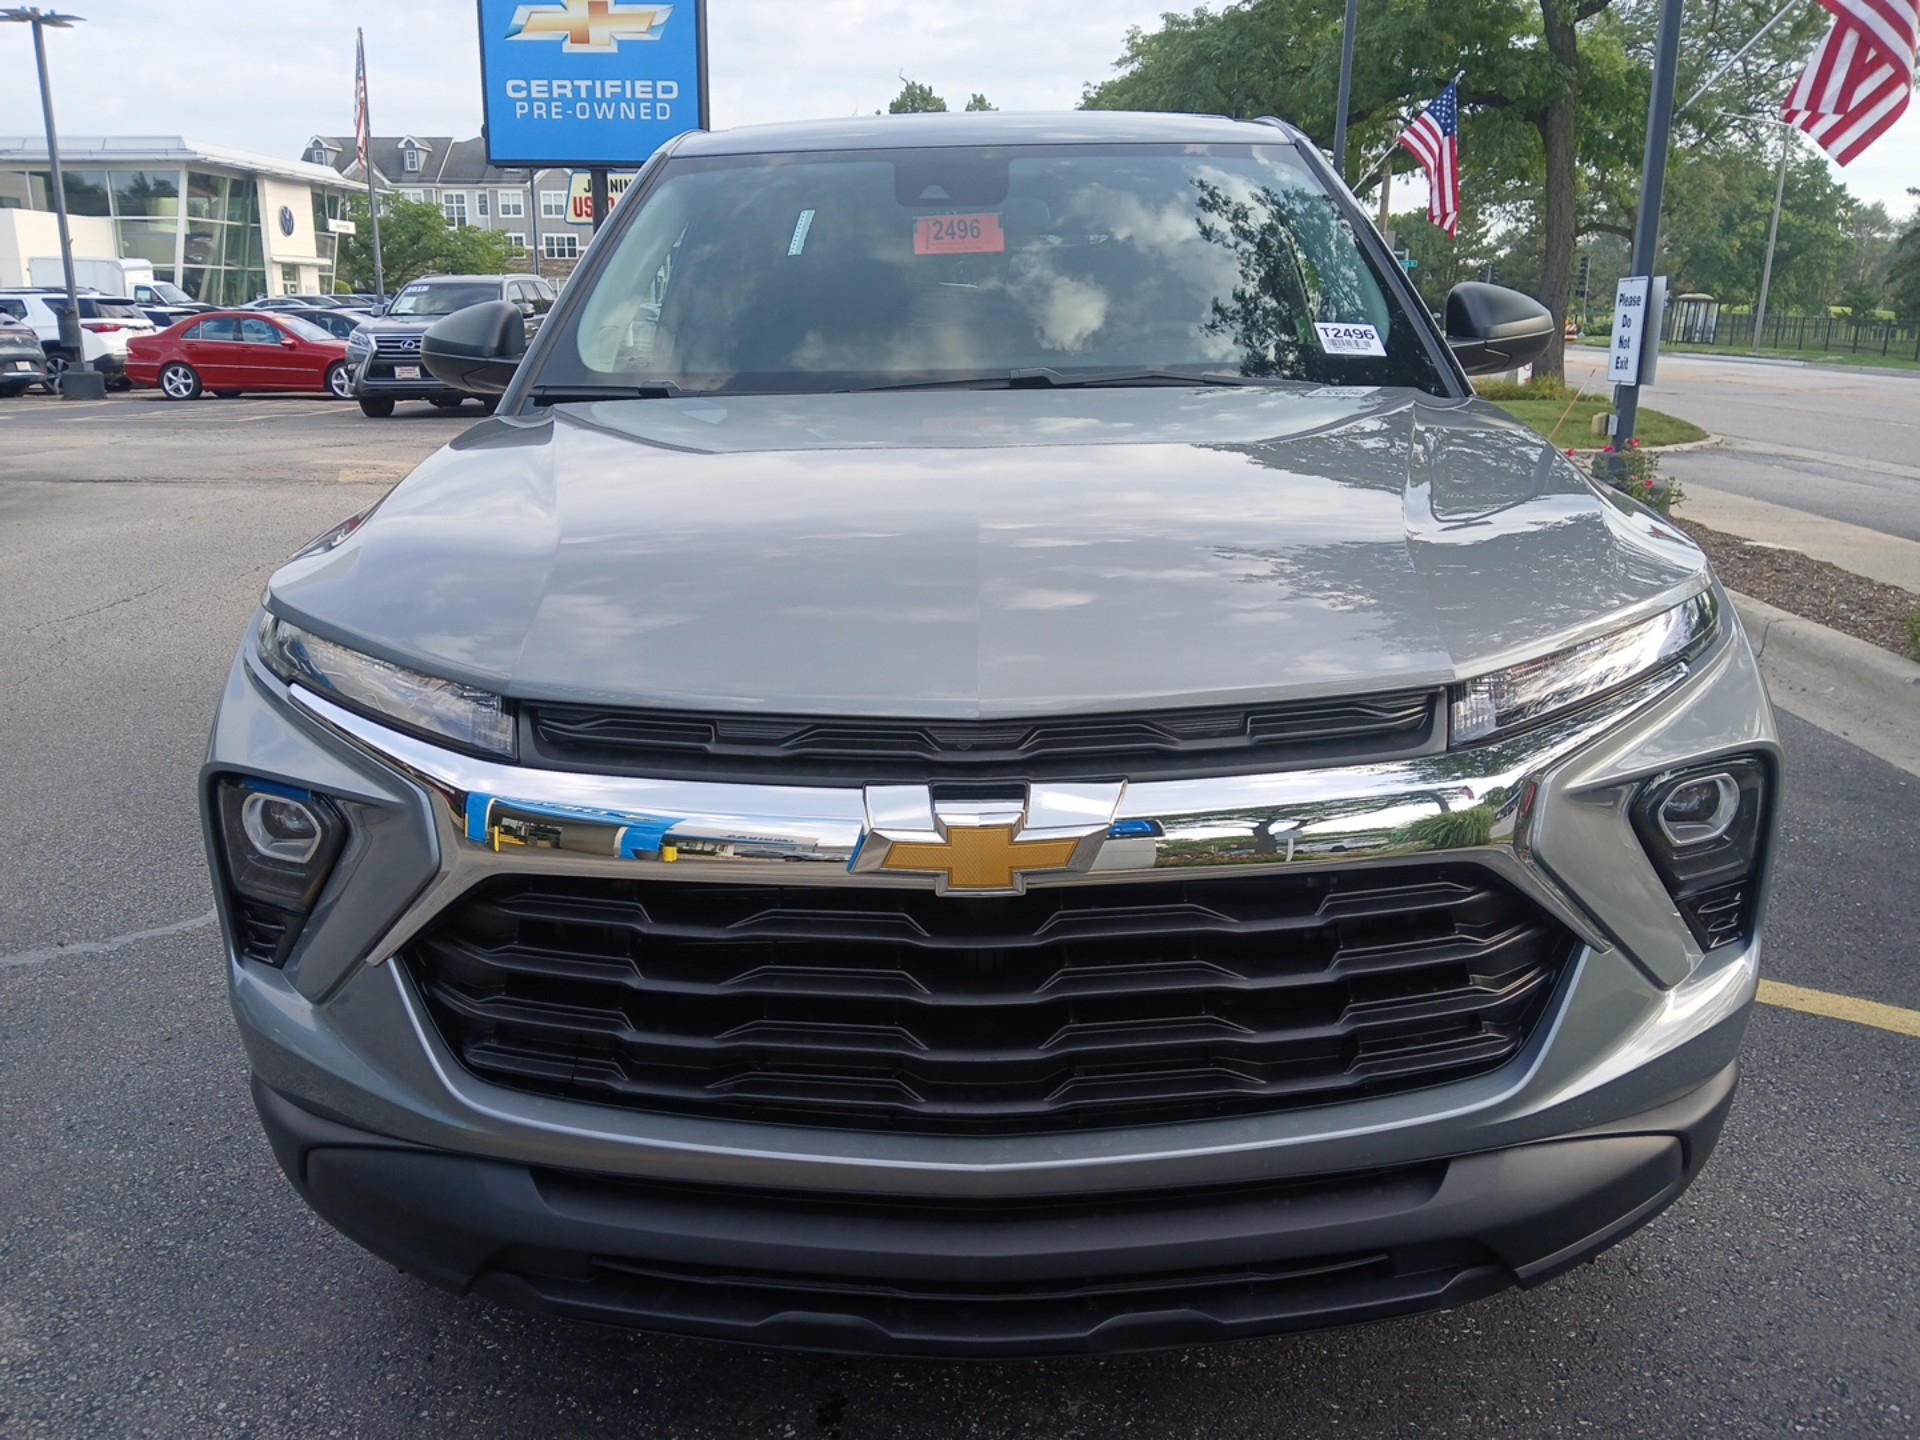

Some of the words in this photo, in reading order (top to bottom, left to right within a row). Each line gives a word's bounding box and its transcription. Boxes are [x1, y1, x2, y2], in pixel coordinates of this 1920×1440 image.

[505, 79, 679, 99] CERTIFIED
[515, 101, 671, 120] PRE-OWNED
[1618, 293, 1642, 308] Please
[1622, 314, 1632, 329] Do
[1320, 327, 1375, 340] T2496
[1618, 336, 1631, 349] Not
[1615, 356, 1629, 370] Exit
